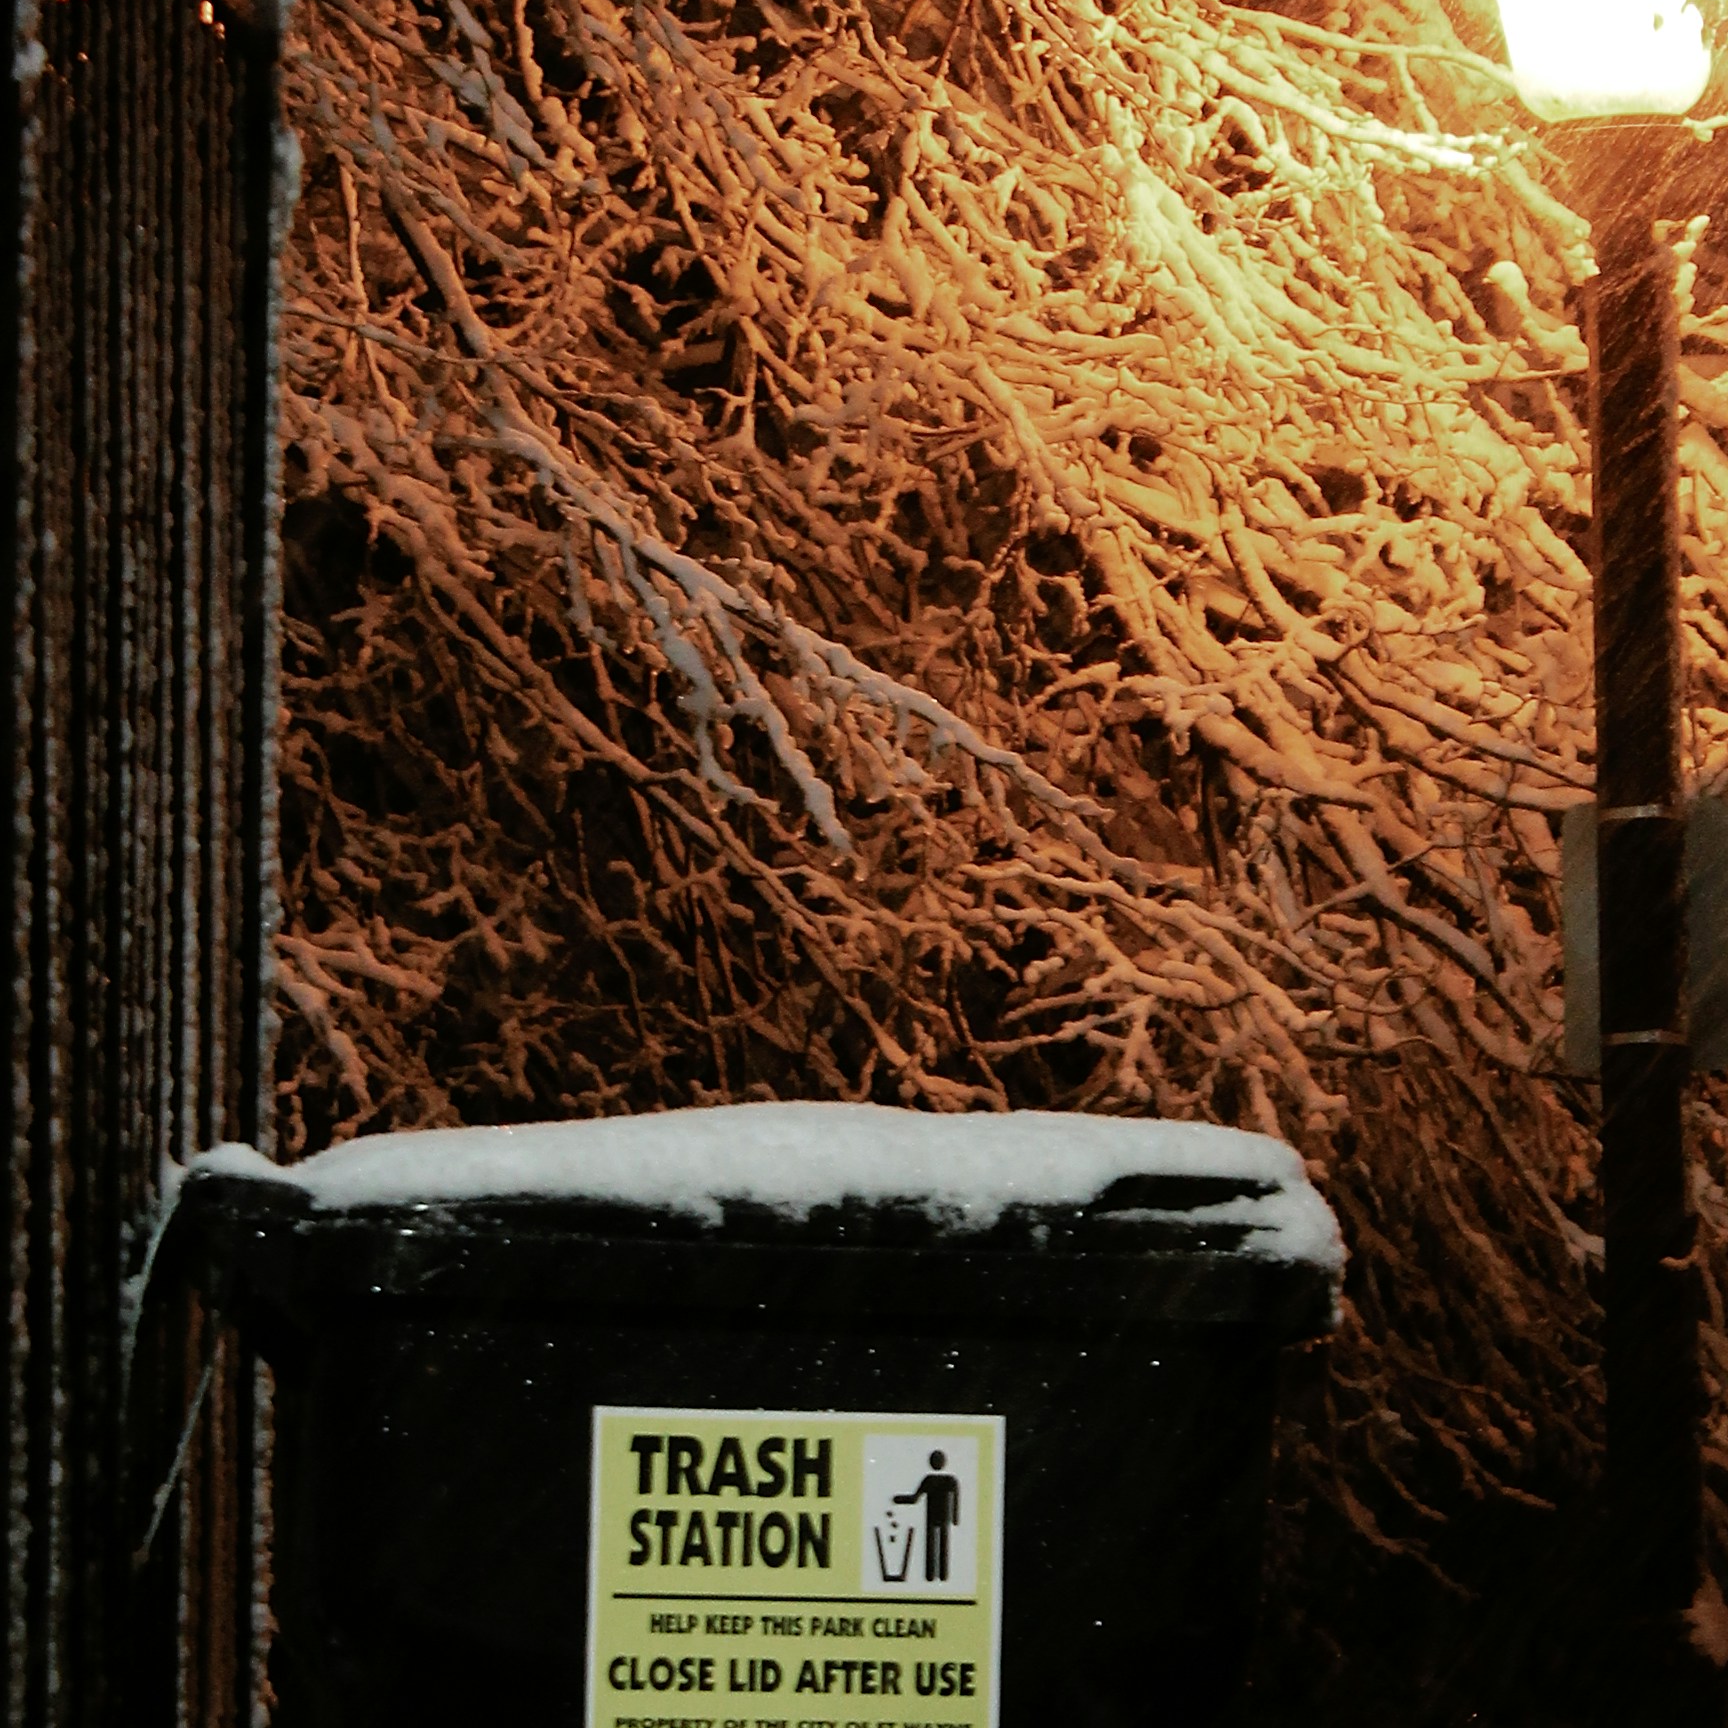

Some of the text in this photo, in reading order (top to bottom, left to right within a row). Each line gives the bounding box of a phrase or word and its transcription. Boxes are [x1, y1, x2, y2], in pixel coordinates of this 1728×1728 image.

[630, 1435, 832, 1498] TRASH
[629, 1509, 831, 1568] STATION
[649, 1614, 937, 1639] HELP KEEP THIS PARK CLEAN
[608, 1656, 976, 1697] CLOSE LID AFTER USE
